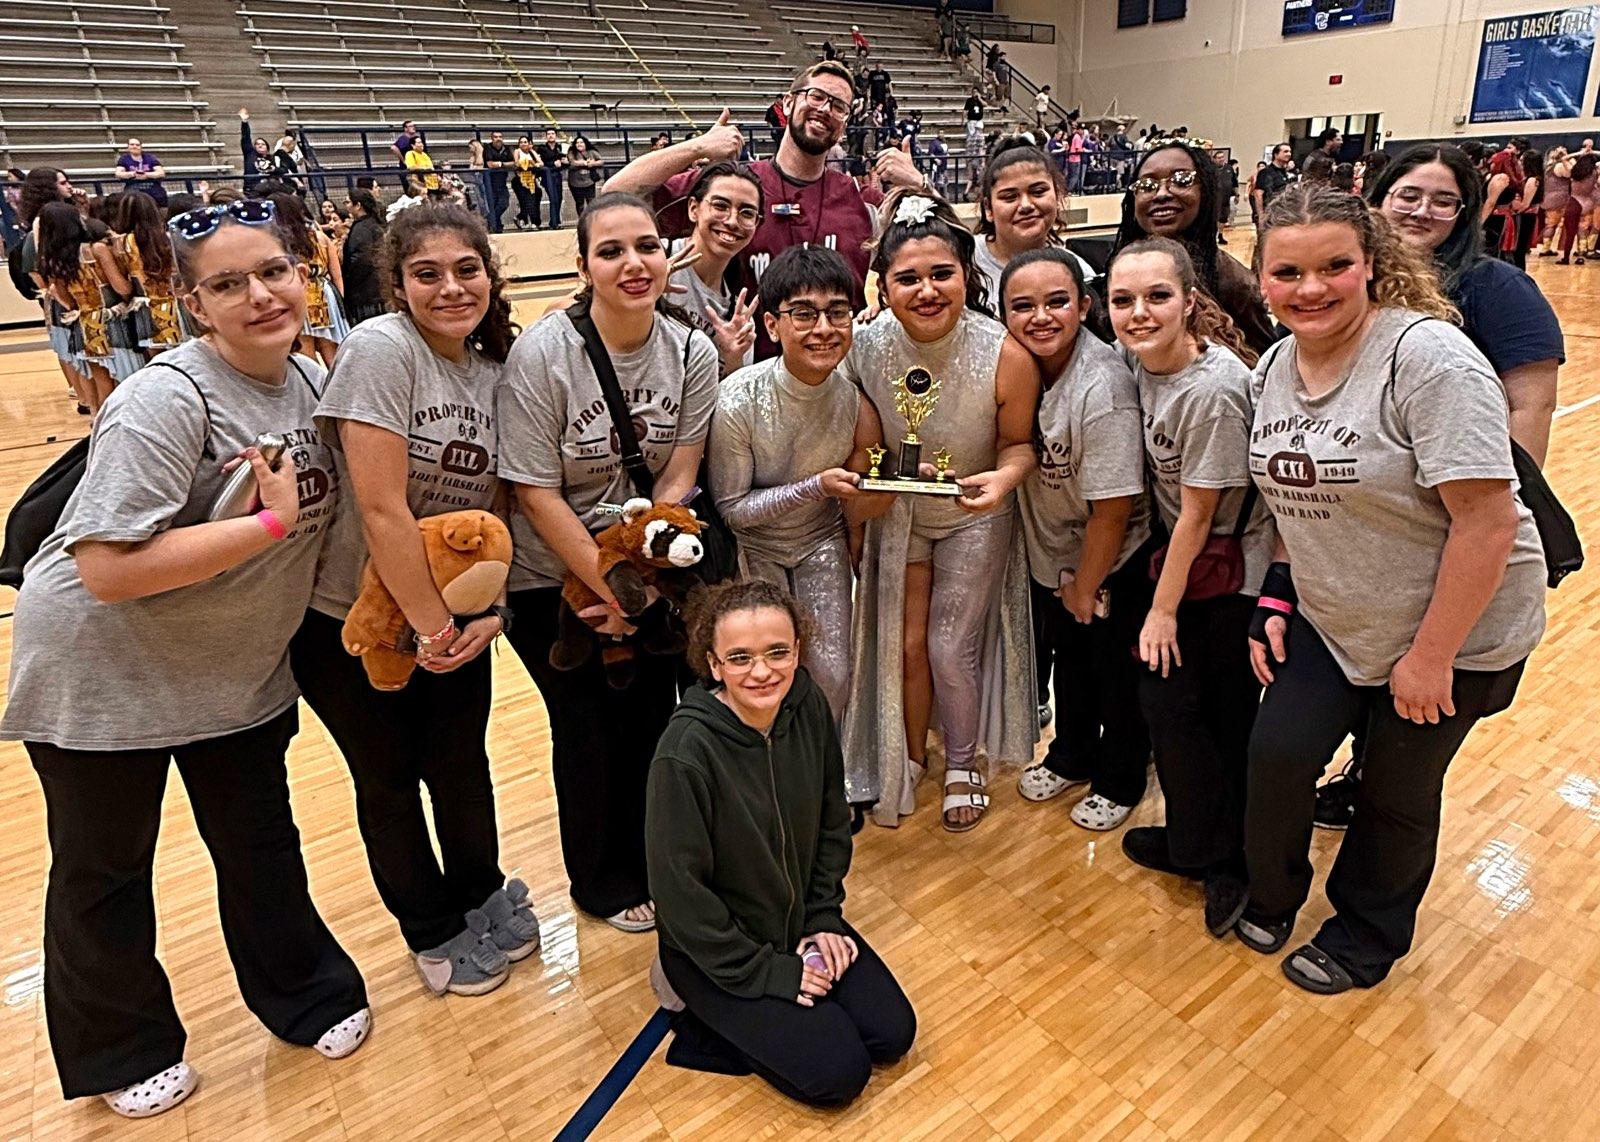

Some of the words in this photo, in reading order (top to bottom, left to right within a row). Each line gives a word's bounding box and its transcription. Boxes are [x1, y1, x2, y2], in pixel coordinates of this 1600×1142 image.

[1485, 20, 1519, 42] GIRLS
[571, 388, 658, 435] PRORTY
[1333, 426, 1361, 449] OF
[1277, 459, 1308, 481] XXL
[1323, 467, 1356, 478] 1949
[1298, 508, 1331, 520] BAND
